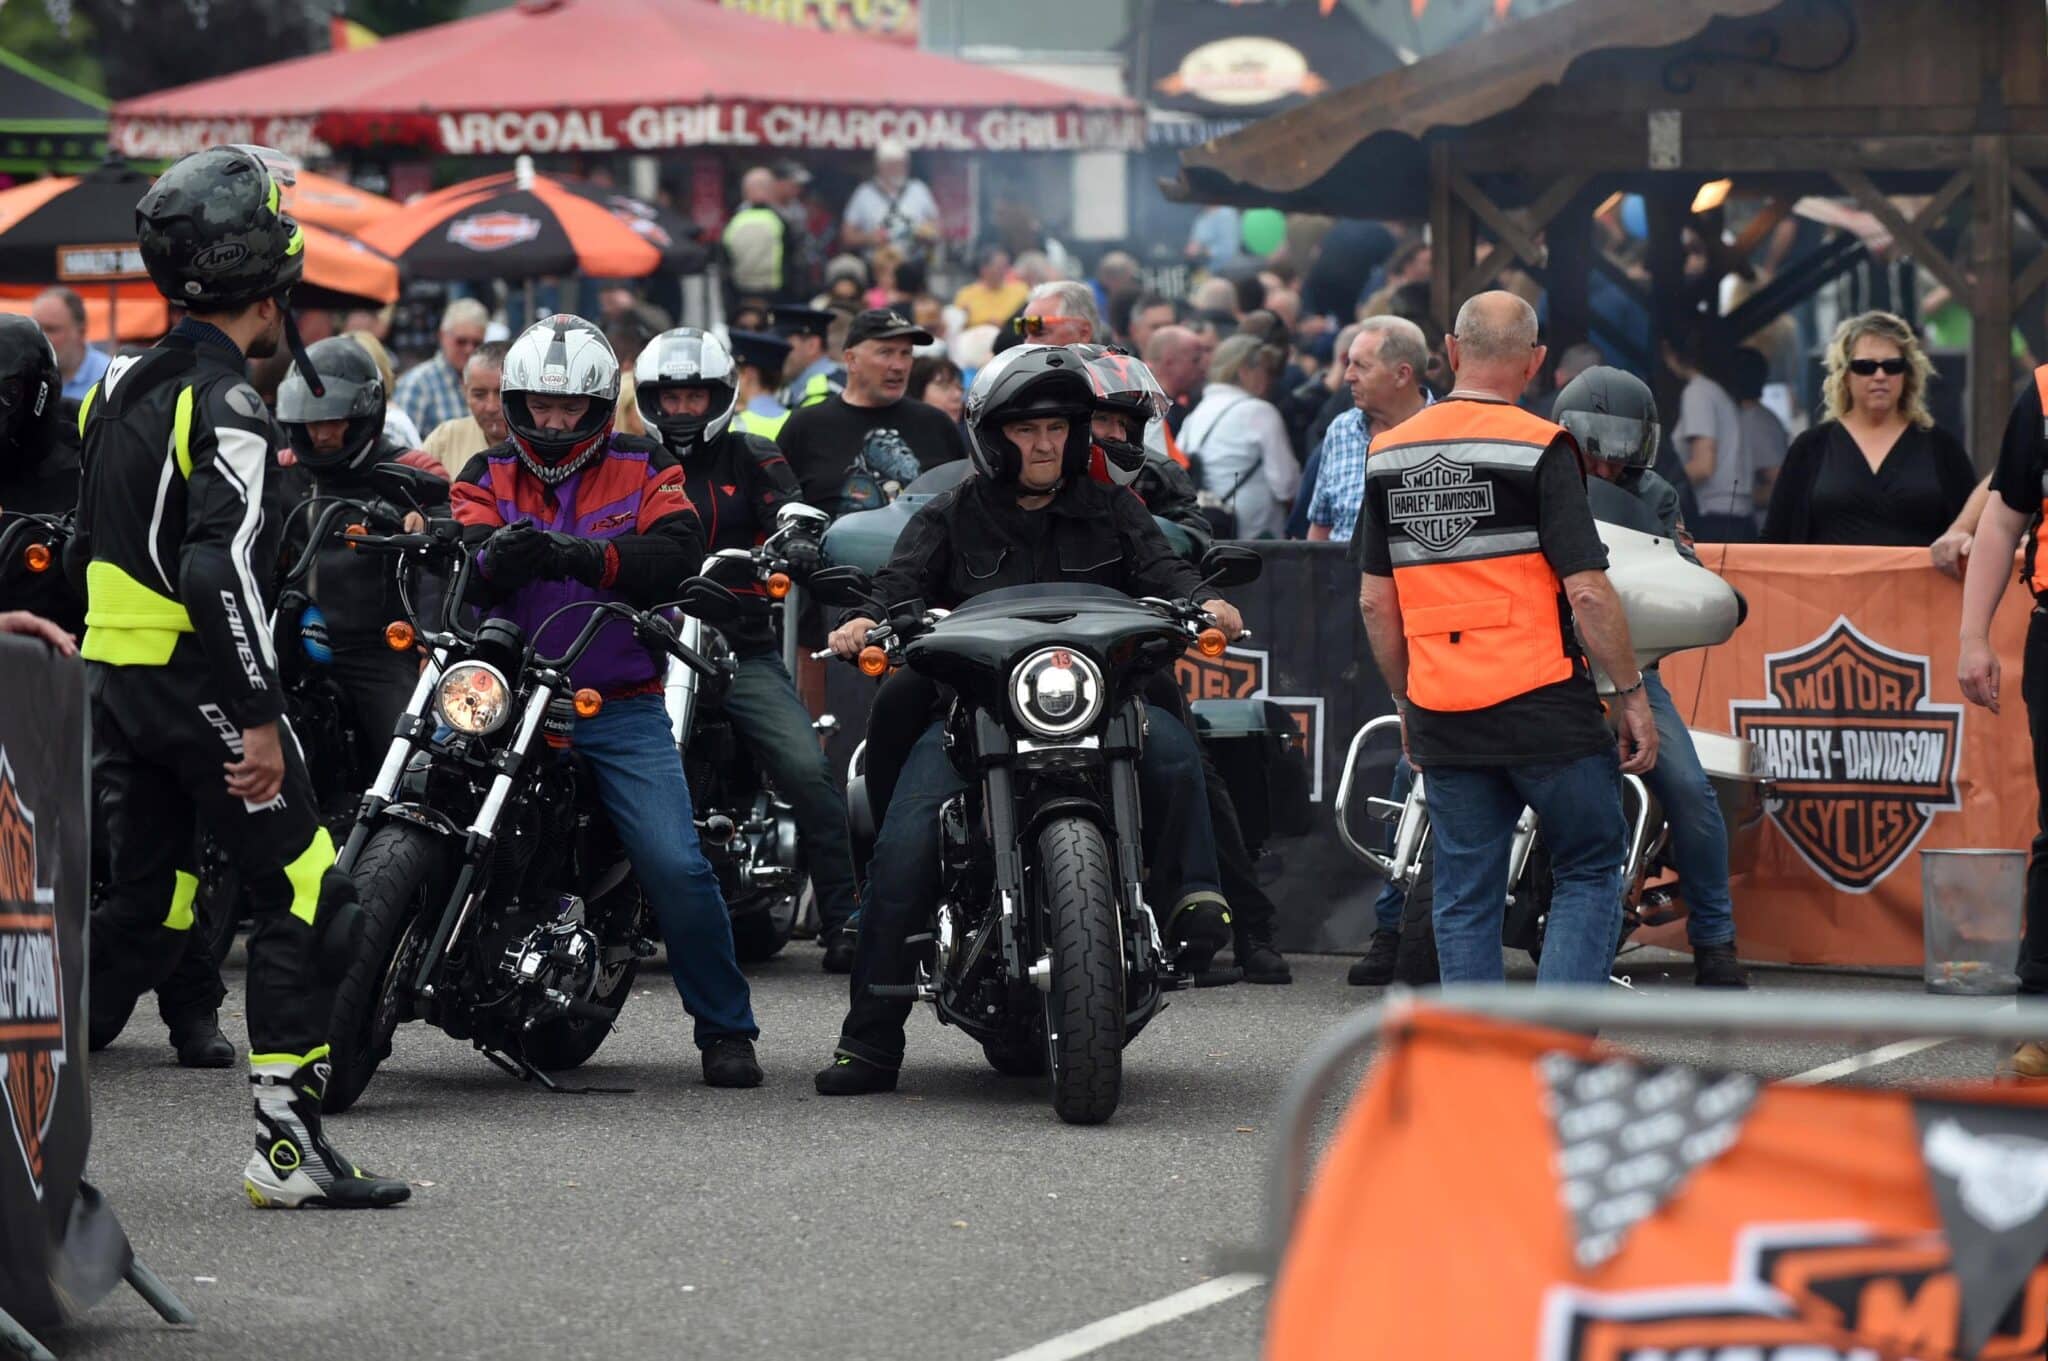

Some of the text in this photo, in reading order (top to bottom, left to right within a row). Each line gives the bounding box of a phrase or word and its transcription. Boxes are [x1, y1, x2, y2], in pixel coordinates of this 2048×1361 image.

[627, 104, 759, 147] GRILL
[761, 105, 974, 150] CHARCOAL
[198, 246, 244, 266] Arai
[1414, 466, 1462, 488] MOTOR
[1394, 489, 1487, 515] HARLEY-DAVIDSON
[1415, 518, 1463, 542] CYCLES
[220, 589, 268, 690] DAINESE
[1793, 651, 1901, 711] MOTOR
[1801, 800, 1904, 867] CYCLES
